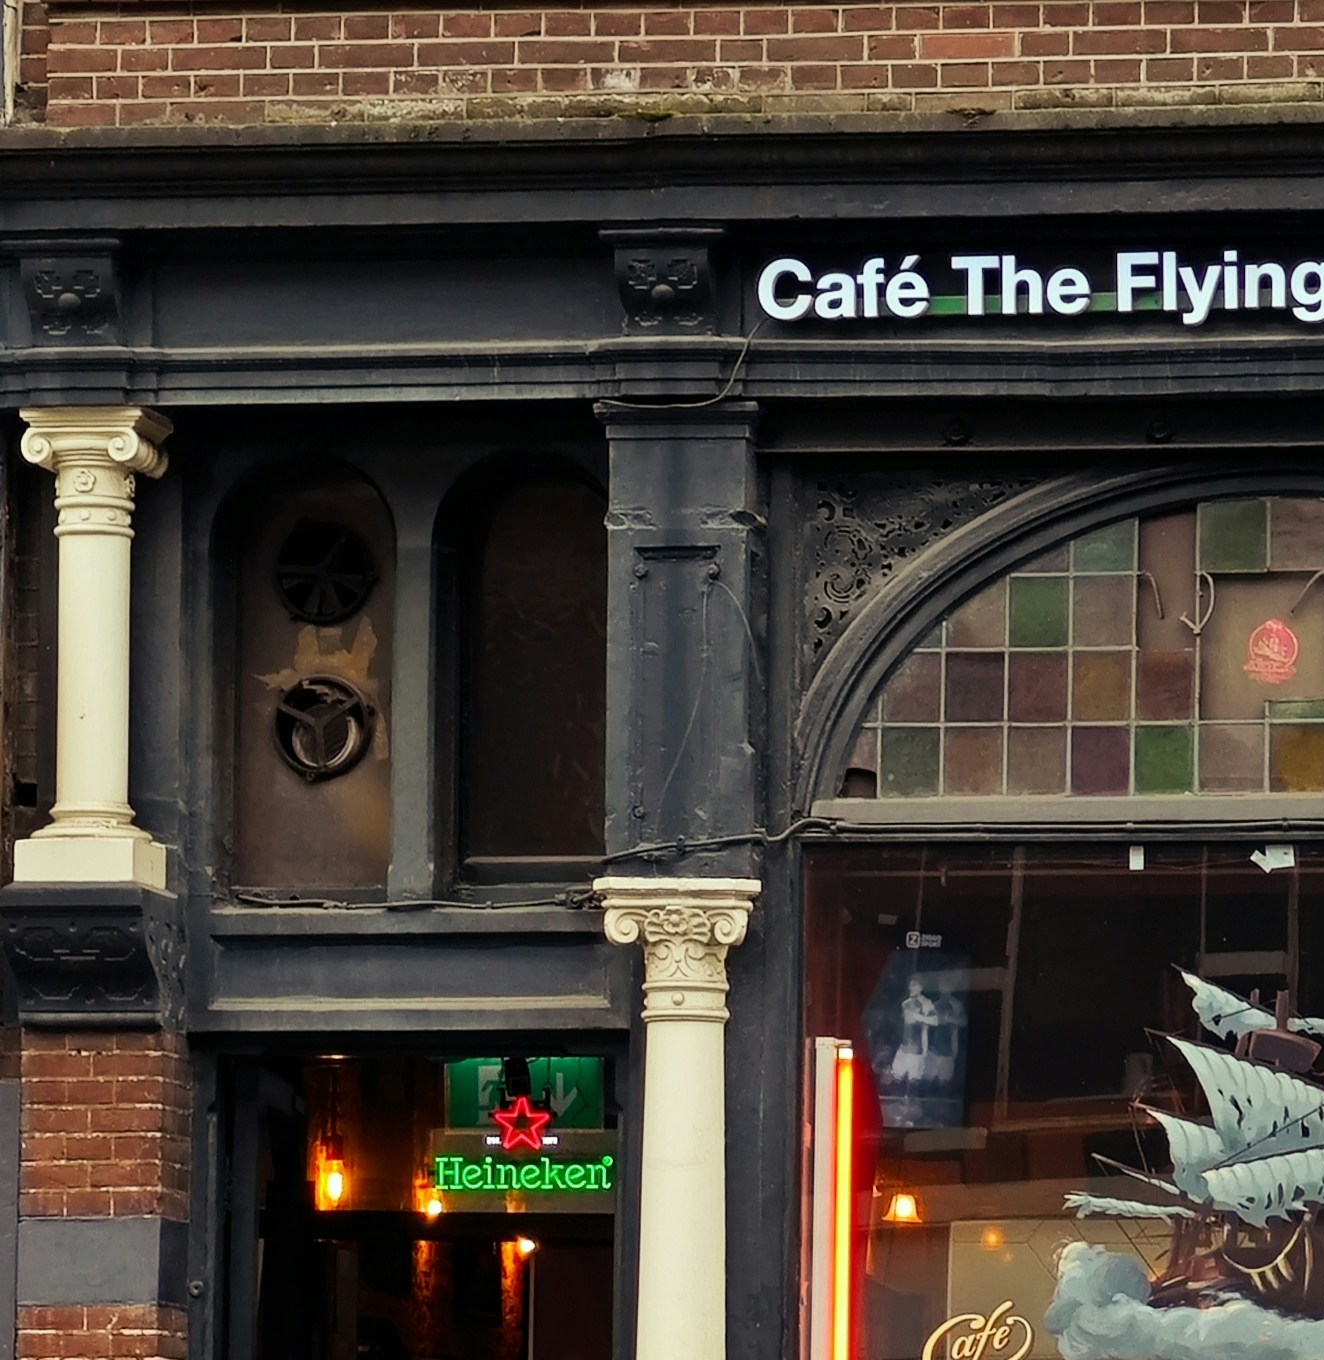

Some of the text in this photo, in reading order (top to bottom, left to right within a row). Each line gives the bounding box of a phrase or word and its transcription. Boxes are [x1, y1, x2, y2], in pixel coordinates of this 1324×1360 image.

[758, 255, 931, 321] Café
[951, 254, 1093, 317] The
[435, 1156, 612, 1191] Heineken
